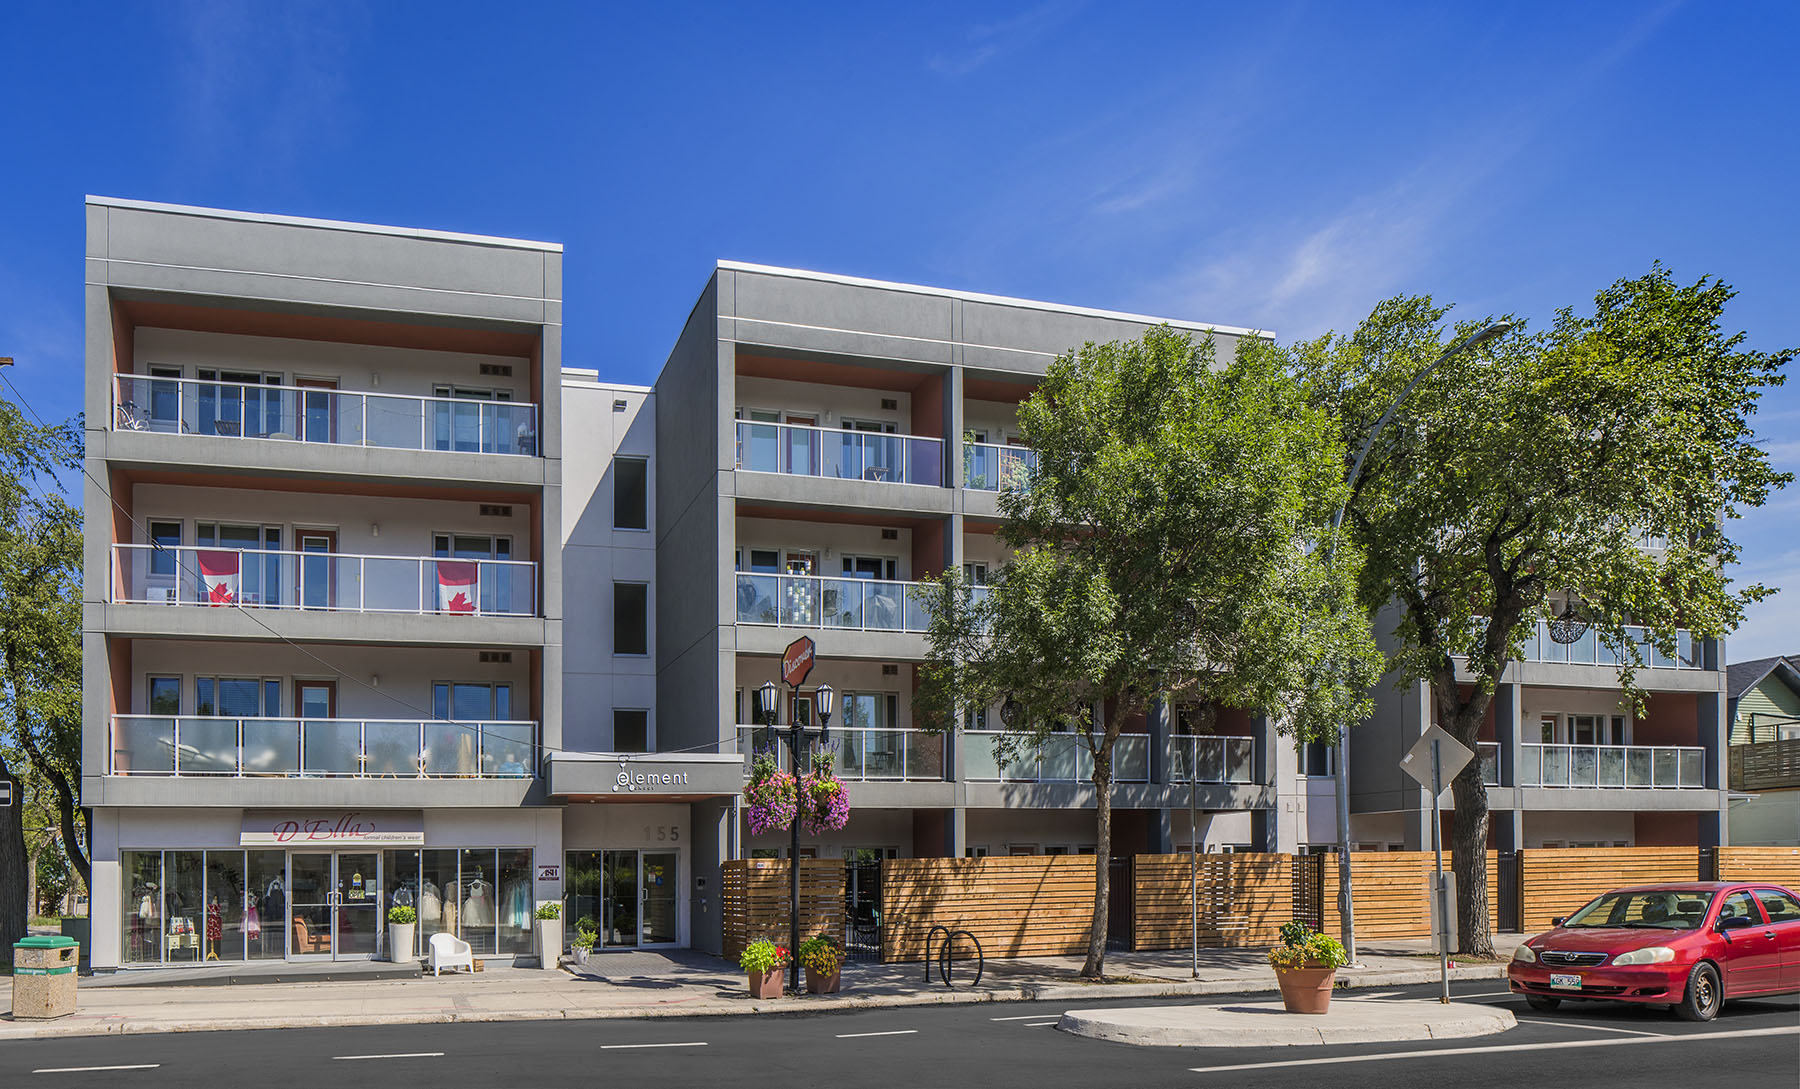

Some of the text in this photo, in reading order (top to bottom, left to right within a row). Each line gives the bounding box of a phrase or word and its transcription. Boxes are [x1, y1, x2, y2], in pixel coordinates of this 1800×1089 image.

[616, 770, 688, 786] element
[272, 812, 376, 842] D'Ella
[643, 826, 679, 841] 155
